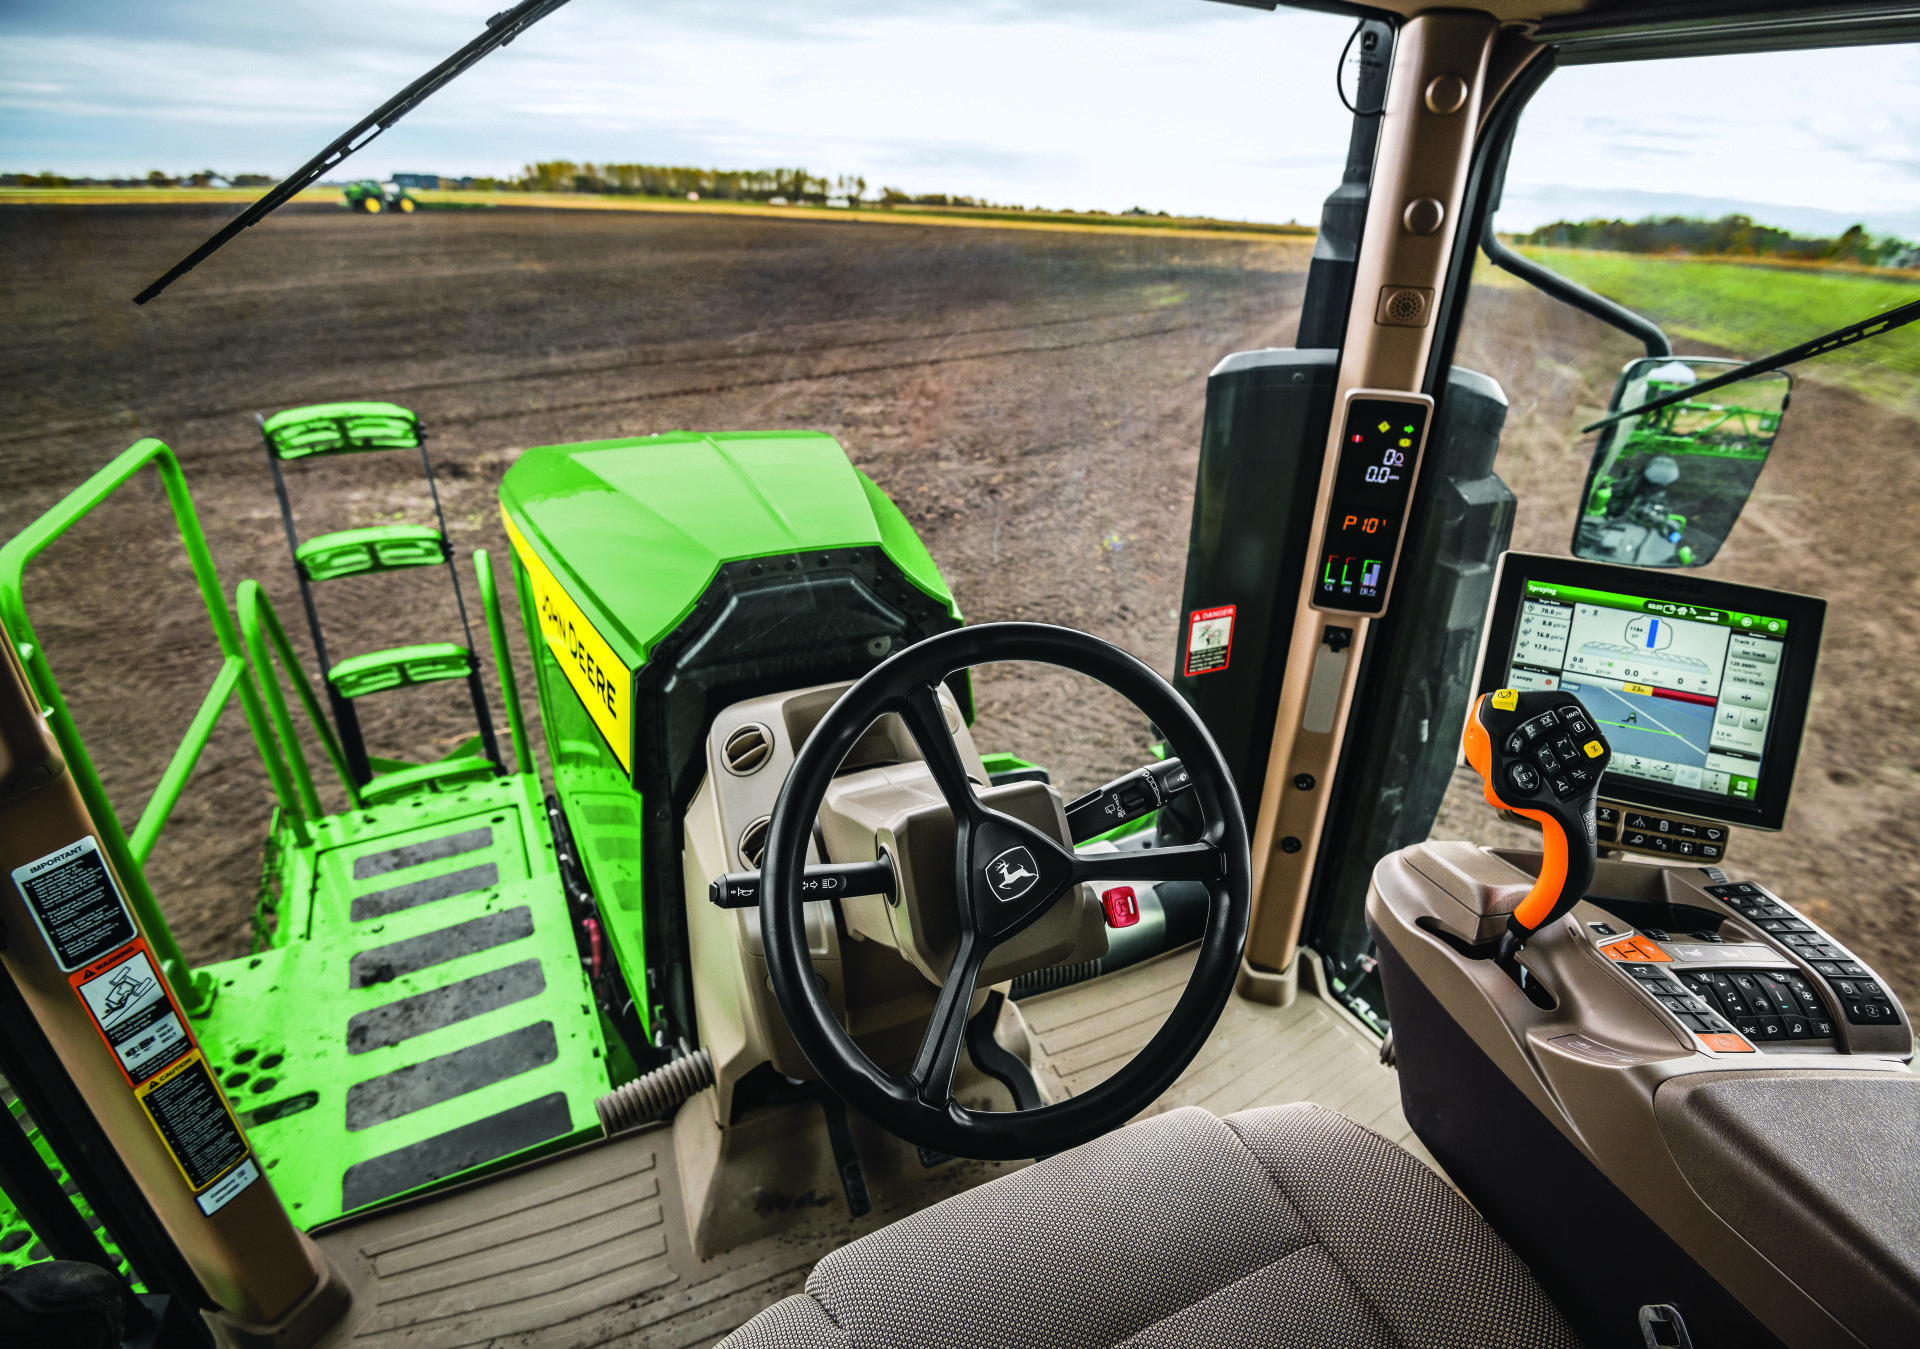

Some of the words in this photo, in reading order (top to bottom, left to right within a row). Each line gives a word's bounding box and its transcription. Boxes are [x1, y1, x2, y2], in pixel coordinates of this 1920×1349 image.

[1365, 465, 1391, 483] 0.0
[1528, 583, 1557, 595] Spraying
[1202, 608, 1233, 619] DANGER
[568, 621, 617, 719] DEERE
[1623, 668, 1639, 677] 0.0
[29, 844, 84, 874] IMPORTANT
[93, 945, 135, 972] WARNING
[157, 1025, 174, 1039] SEAT
[158, 1056, 192, 1082] CAUTION
